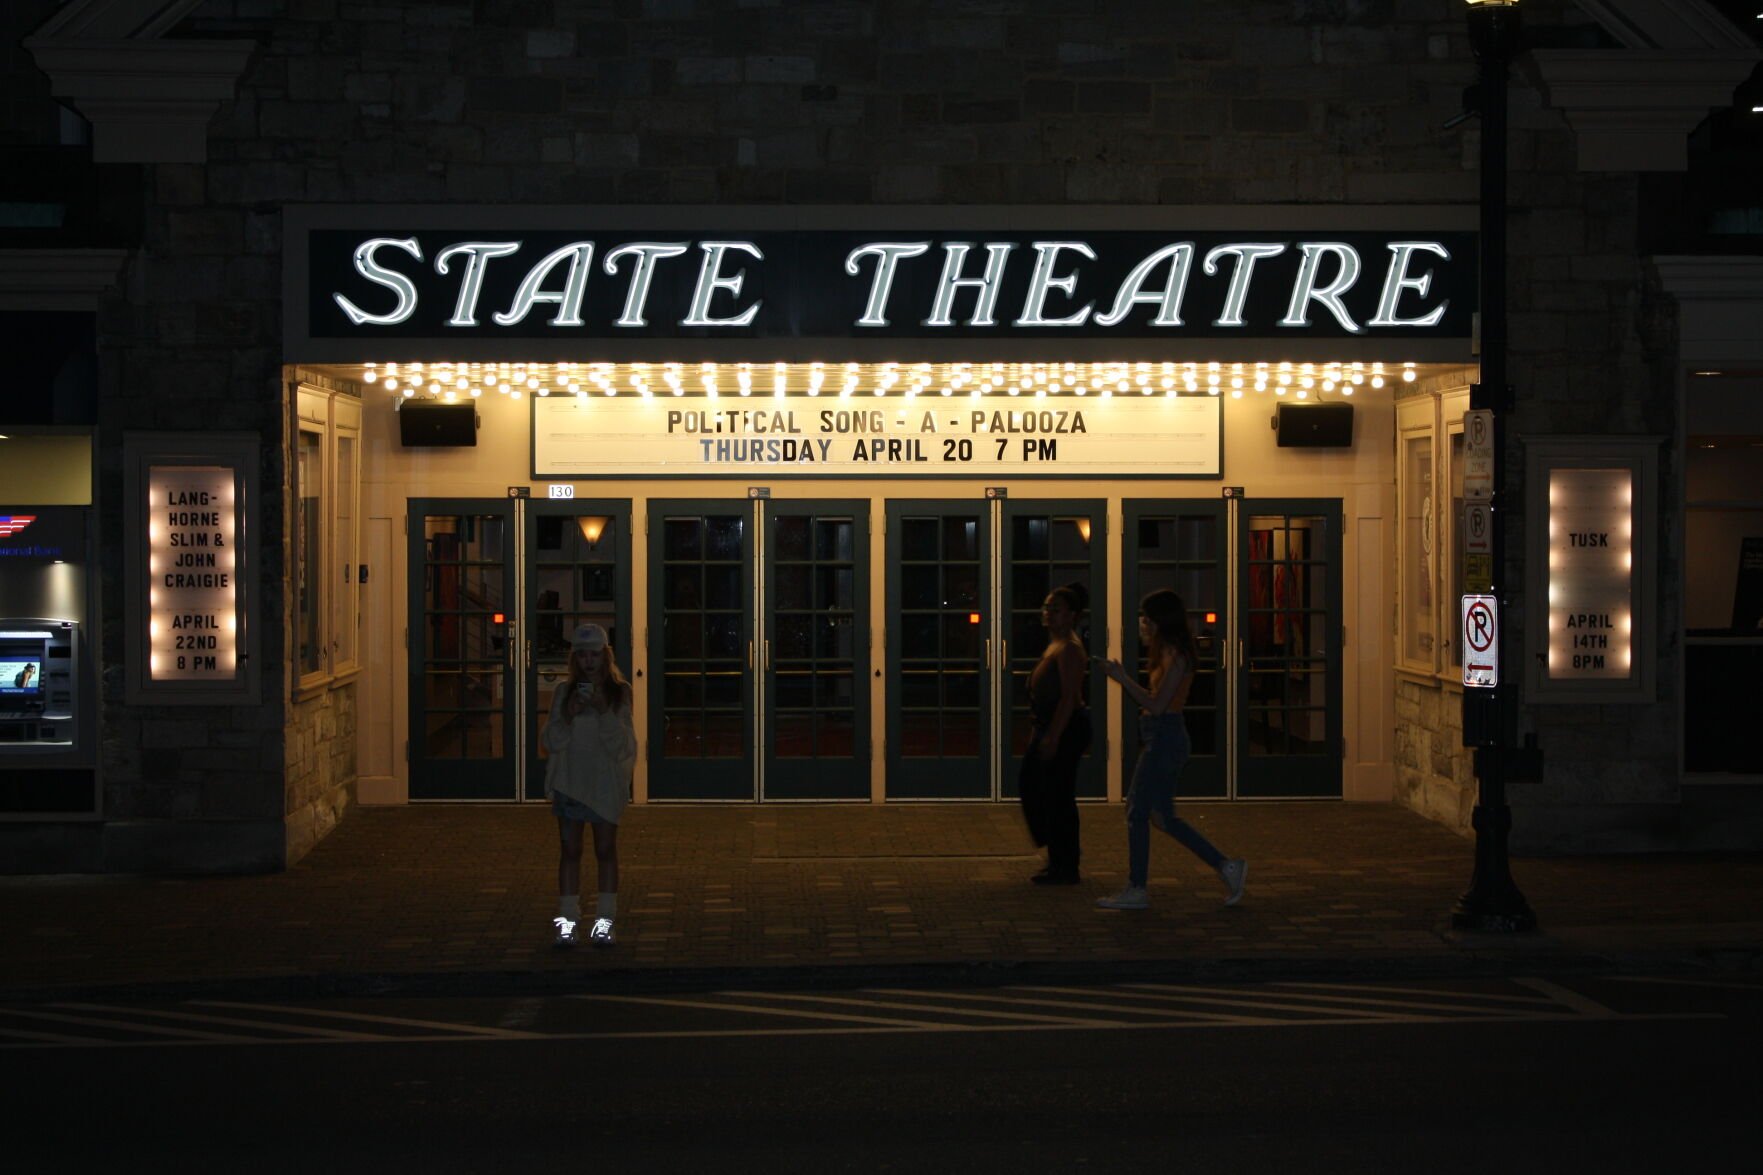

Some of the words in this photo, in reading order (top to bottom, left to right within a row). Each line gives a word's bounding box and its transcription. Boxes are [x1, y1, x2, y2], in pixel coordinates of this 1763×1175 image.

[333, 237, 765, 327] STATE
[845, 237, 1452, 334] THEATRE
[820, 410, 884, 434] SONG
[920, 410, 936, 434] A
[971, 410, 1087, 434] PALOOZA
[699, 438, 833, 462] THURSDAY
[852, 438, 928, 462] APRIL
[943, 438, 973, 462] 20
[995, 438, 1008, 461] 7
[1023, 438, 1057, 461] PM
[168, 491, 217, 506] LANG-
[551, 486, 572, 497] 130
[169, 512, 219, 526] HORNE
[170, 533, 208, 547] SLIM
[214, 533, 225, 547] &
[1569, 533, 1608, 547] TUSK
[175, 553, 216, 567] JOHN
[165, 574, 228, 588] CRAIGIE
[172, 615, 219, 629] APRIL
[1567, 614, 1613, 629] APRIL
[176, 636, 217, 650] 22ND
[1573, 635, 1608, 649] 14TH
[177, 656, 185, 670] 8
[194, 656, 216, 670] PM
